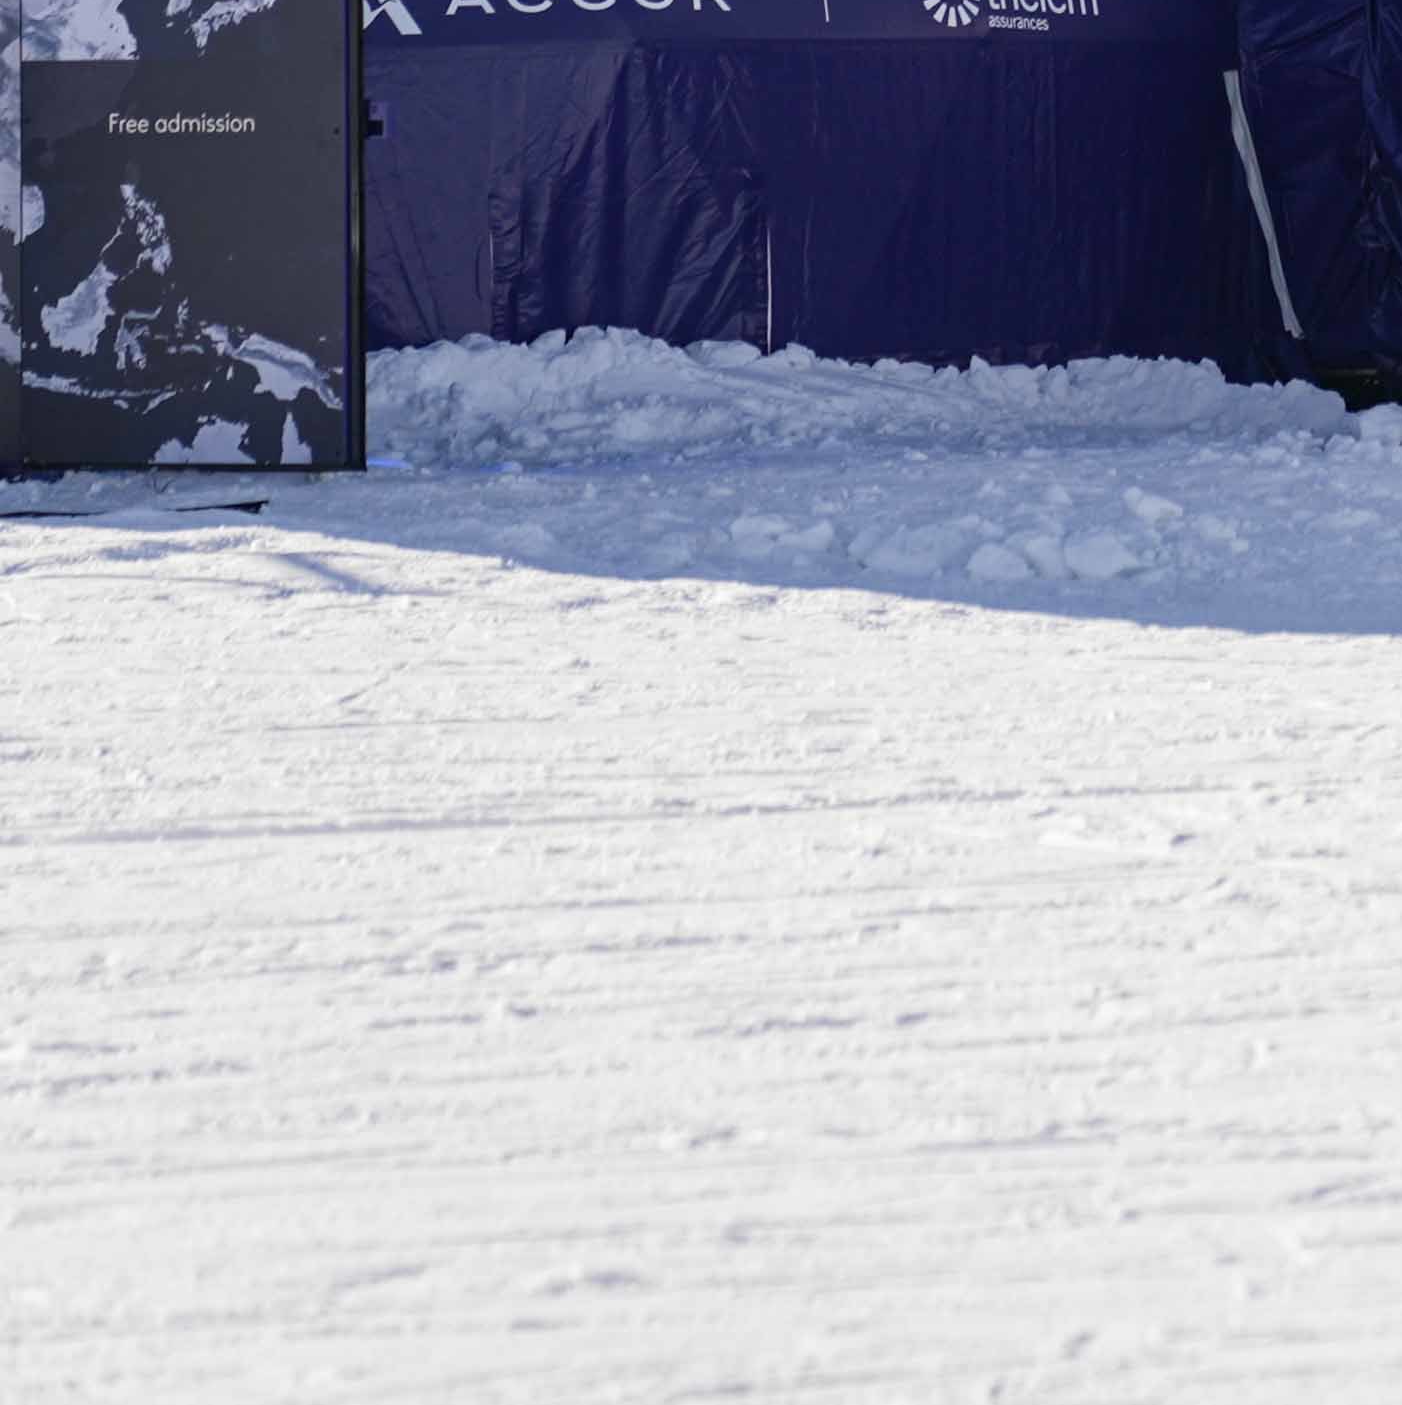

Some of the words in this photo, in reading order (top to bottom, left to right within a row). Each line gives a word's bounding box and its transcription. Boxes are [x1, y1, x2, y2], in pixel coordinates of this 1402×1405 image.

[988, 15, 1049, 31] assurances
[108, 112, 149, 134] Free
[154, 111, 256, 134] admission
